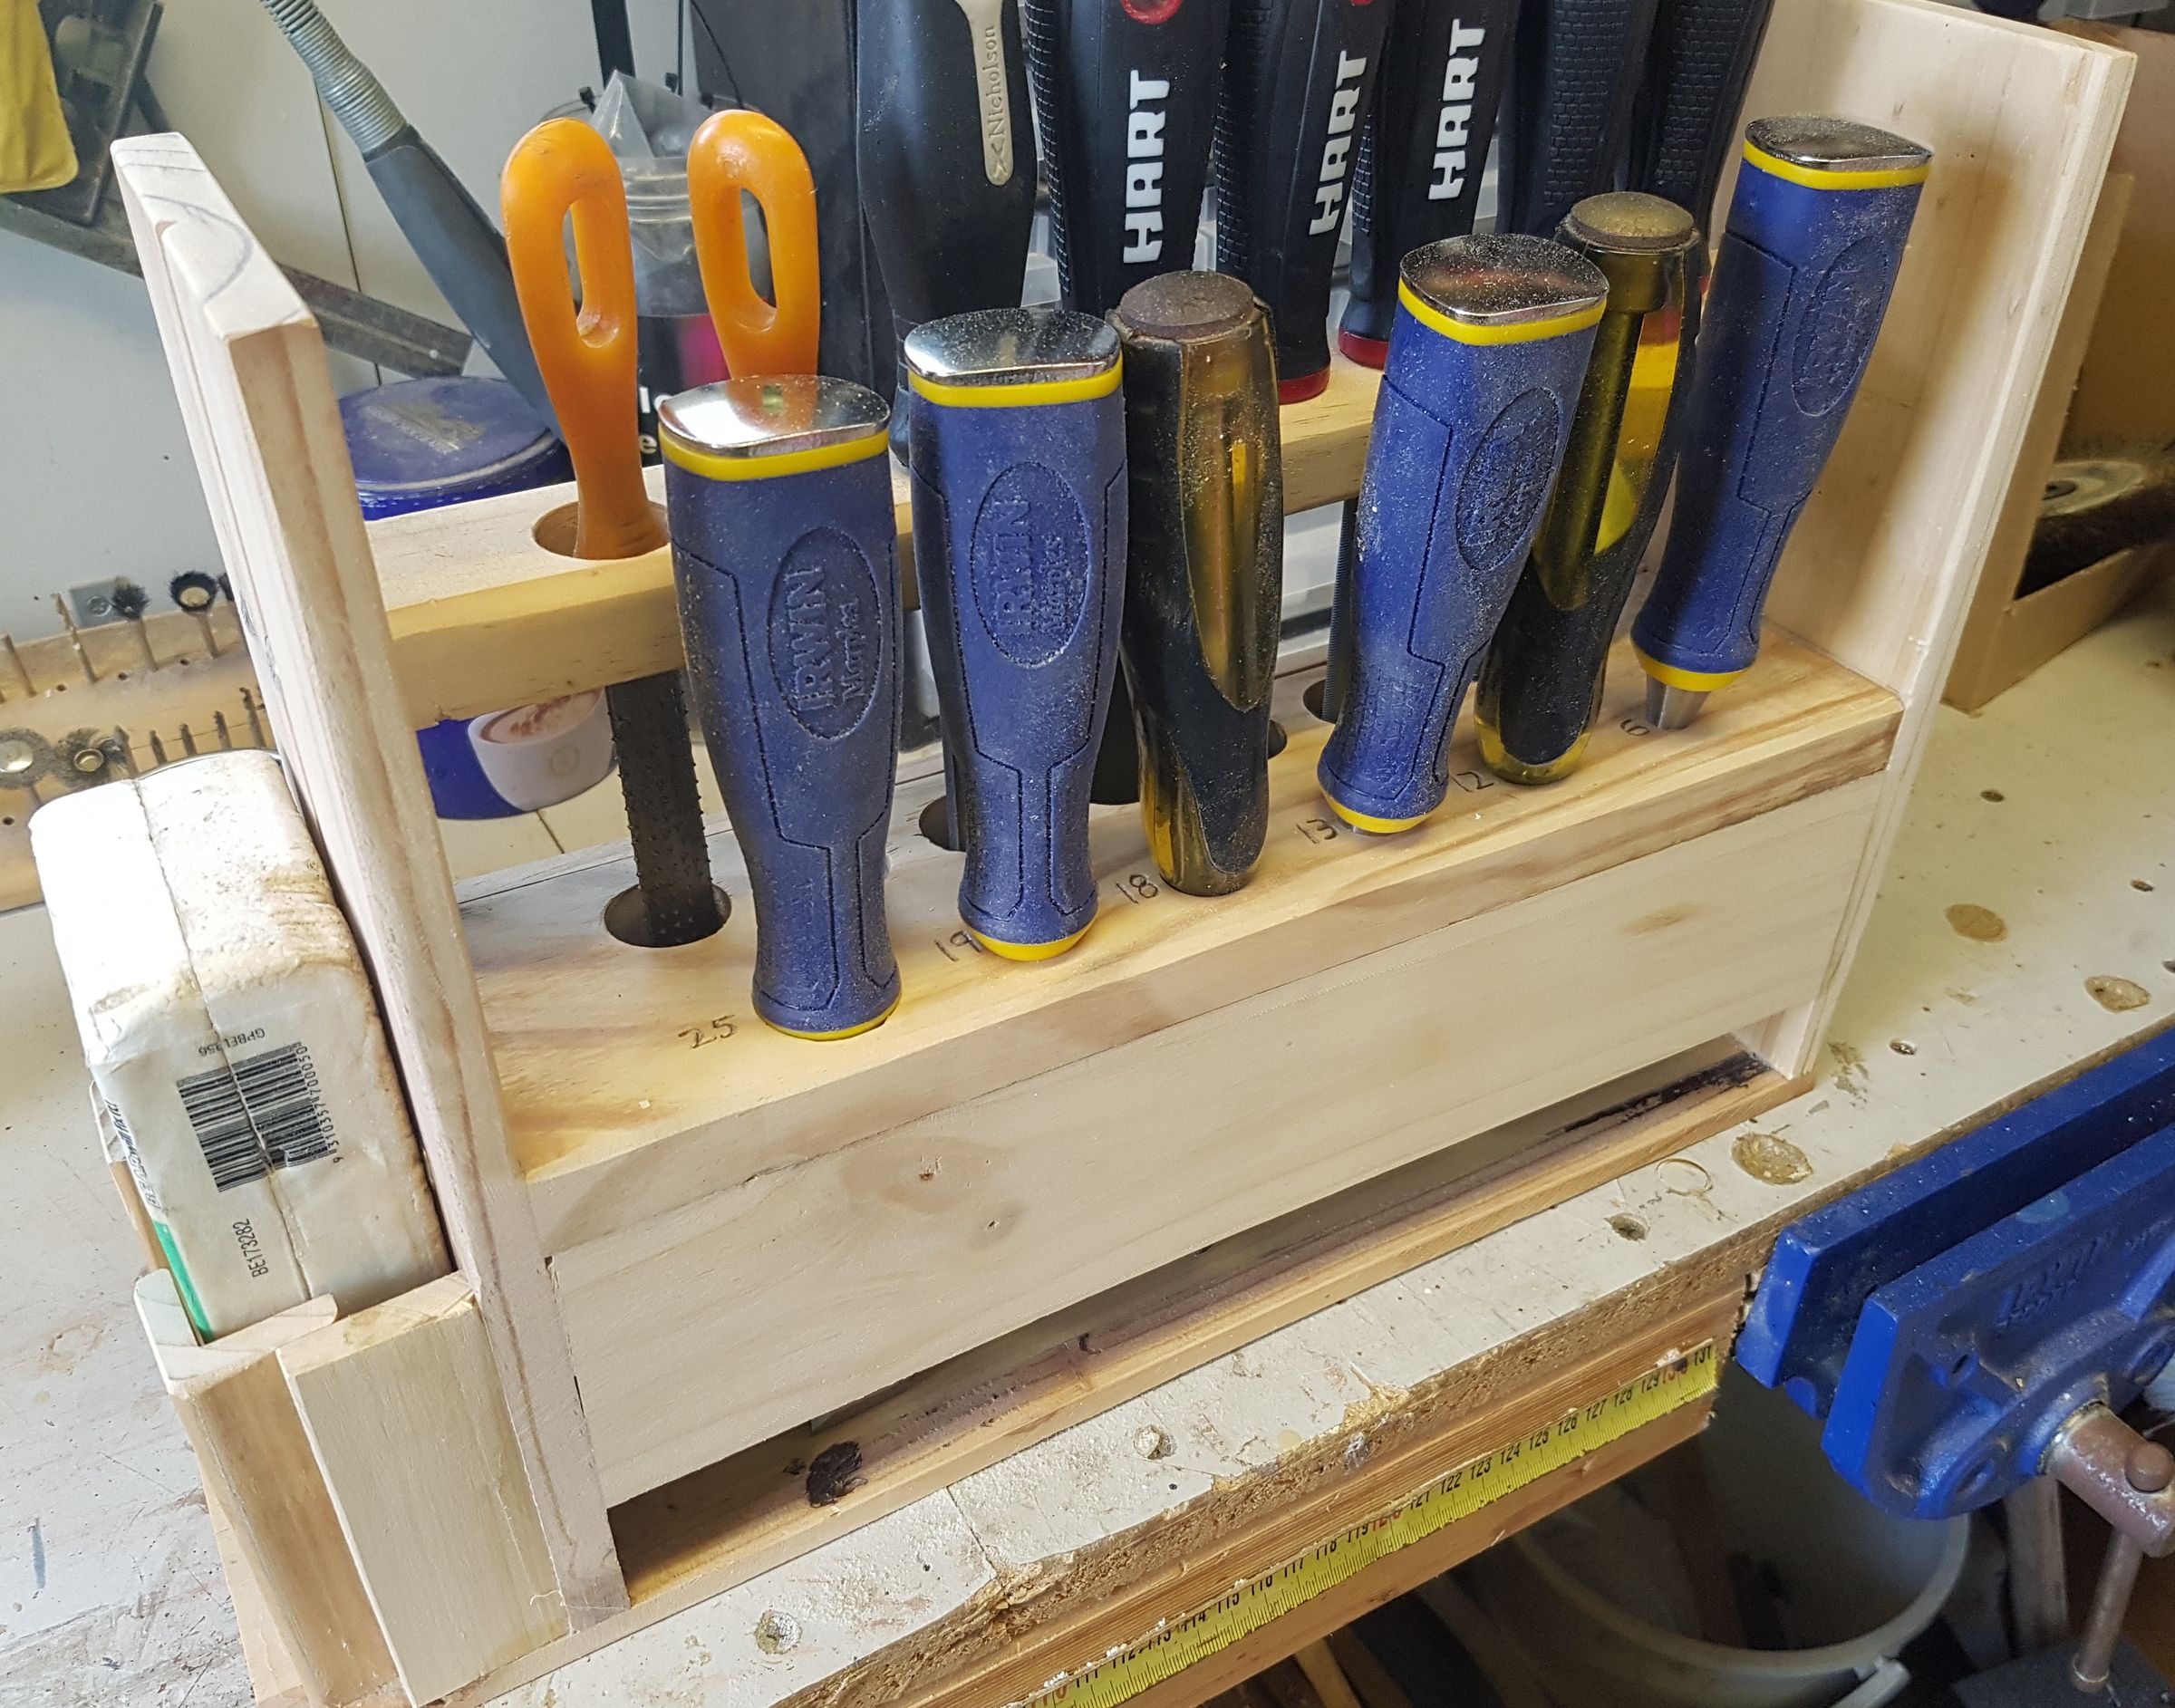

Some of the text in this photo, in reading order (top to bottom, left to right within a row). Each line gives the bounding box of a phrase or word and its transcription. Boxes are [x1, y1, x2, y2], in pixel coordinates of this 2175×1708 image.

[981, 25, 1006, 137] Nicholson
[1428, 18, 1486, 201] HART
[1122, 70, 1171, 265] HART
[1309, 50, 1367, 236] HART
[991, 500, 1032, 635] IRWIN
[784, 566, 836, 710] IRWIN
[1449, 771, 1494, 793] 12
[1296, 819, 1339, 844] 13
[1116, 874, 1158, 904] 18
[933, 930, 981, 961] 19
[678, 1014, 737, 1049] 25
[295, 1046, 323, 1095] 700050
[315, 1103, 340, 1150] 310357
[232, 1218, 269, 1278] BE173282
[1440, 1472, 1463, 1495] 122
[1470, 1457, 1493, 1481] 123
[1501, 1443, 1522, 1465] 124
[1529, 1429, 1551, 1451] 125
[1558, 1414, 1578, 1436] 126
[1586, 1398, 1608, 1422] 127
[1614, 1386, 1633, 1407] 128
[1641, 1371, 1661, 1394] 129
[1694, 1345, 1713, 1366] 131
